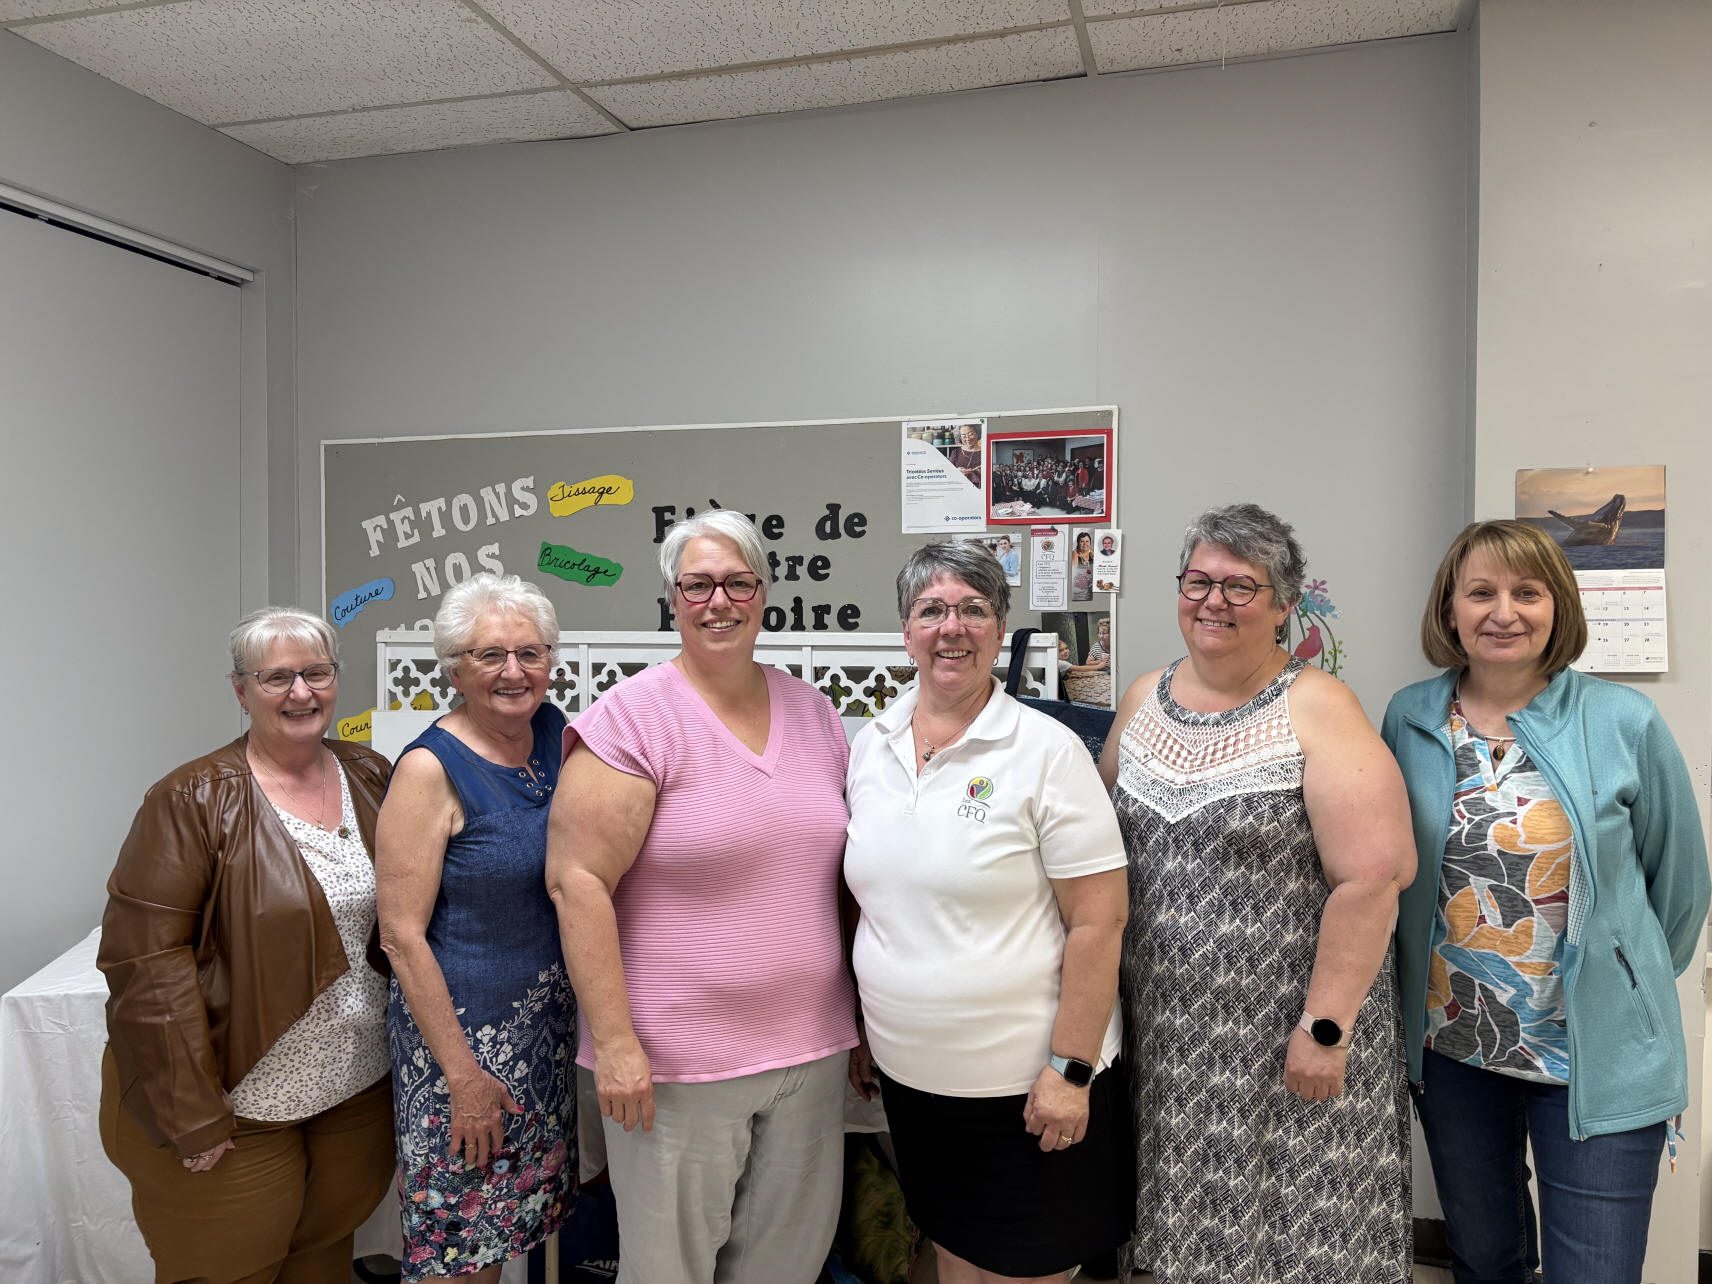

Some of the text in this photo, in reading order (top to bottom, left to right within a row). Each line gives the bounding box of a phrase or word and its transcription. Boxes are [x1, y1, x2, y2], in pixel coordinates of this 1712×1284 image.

[550, 481, 620, 505] Tissage
[361, 476, 538, 557] FÊTONS
[815, 503, 868, 541] de
[411, 542, 504, 600] NOS
[538, 547, 617, 582] Bricolage
[767, 551, 831, 583] tre
[334, 584, 385, 622] Couture
[957, 804, 985, 824] CFQ
